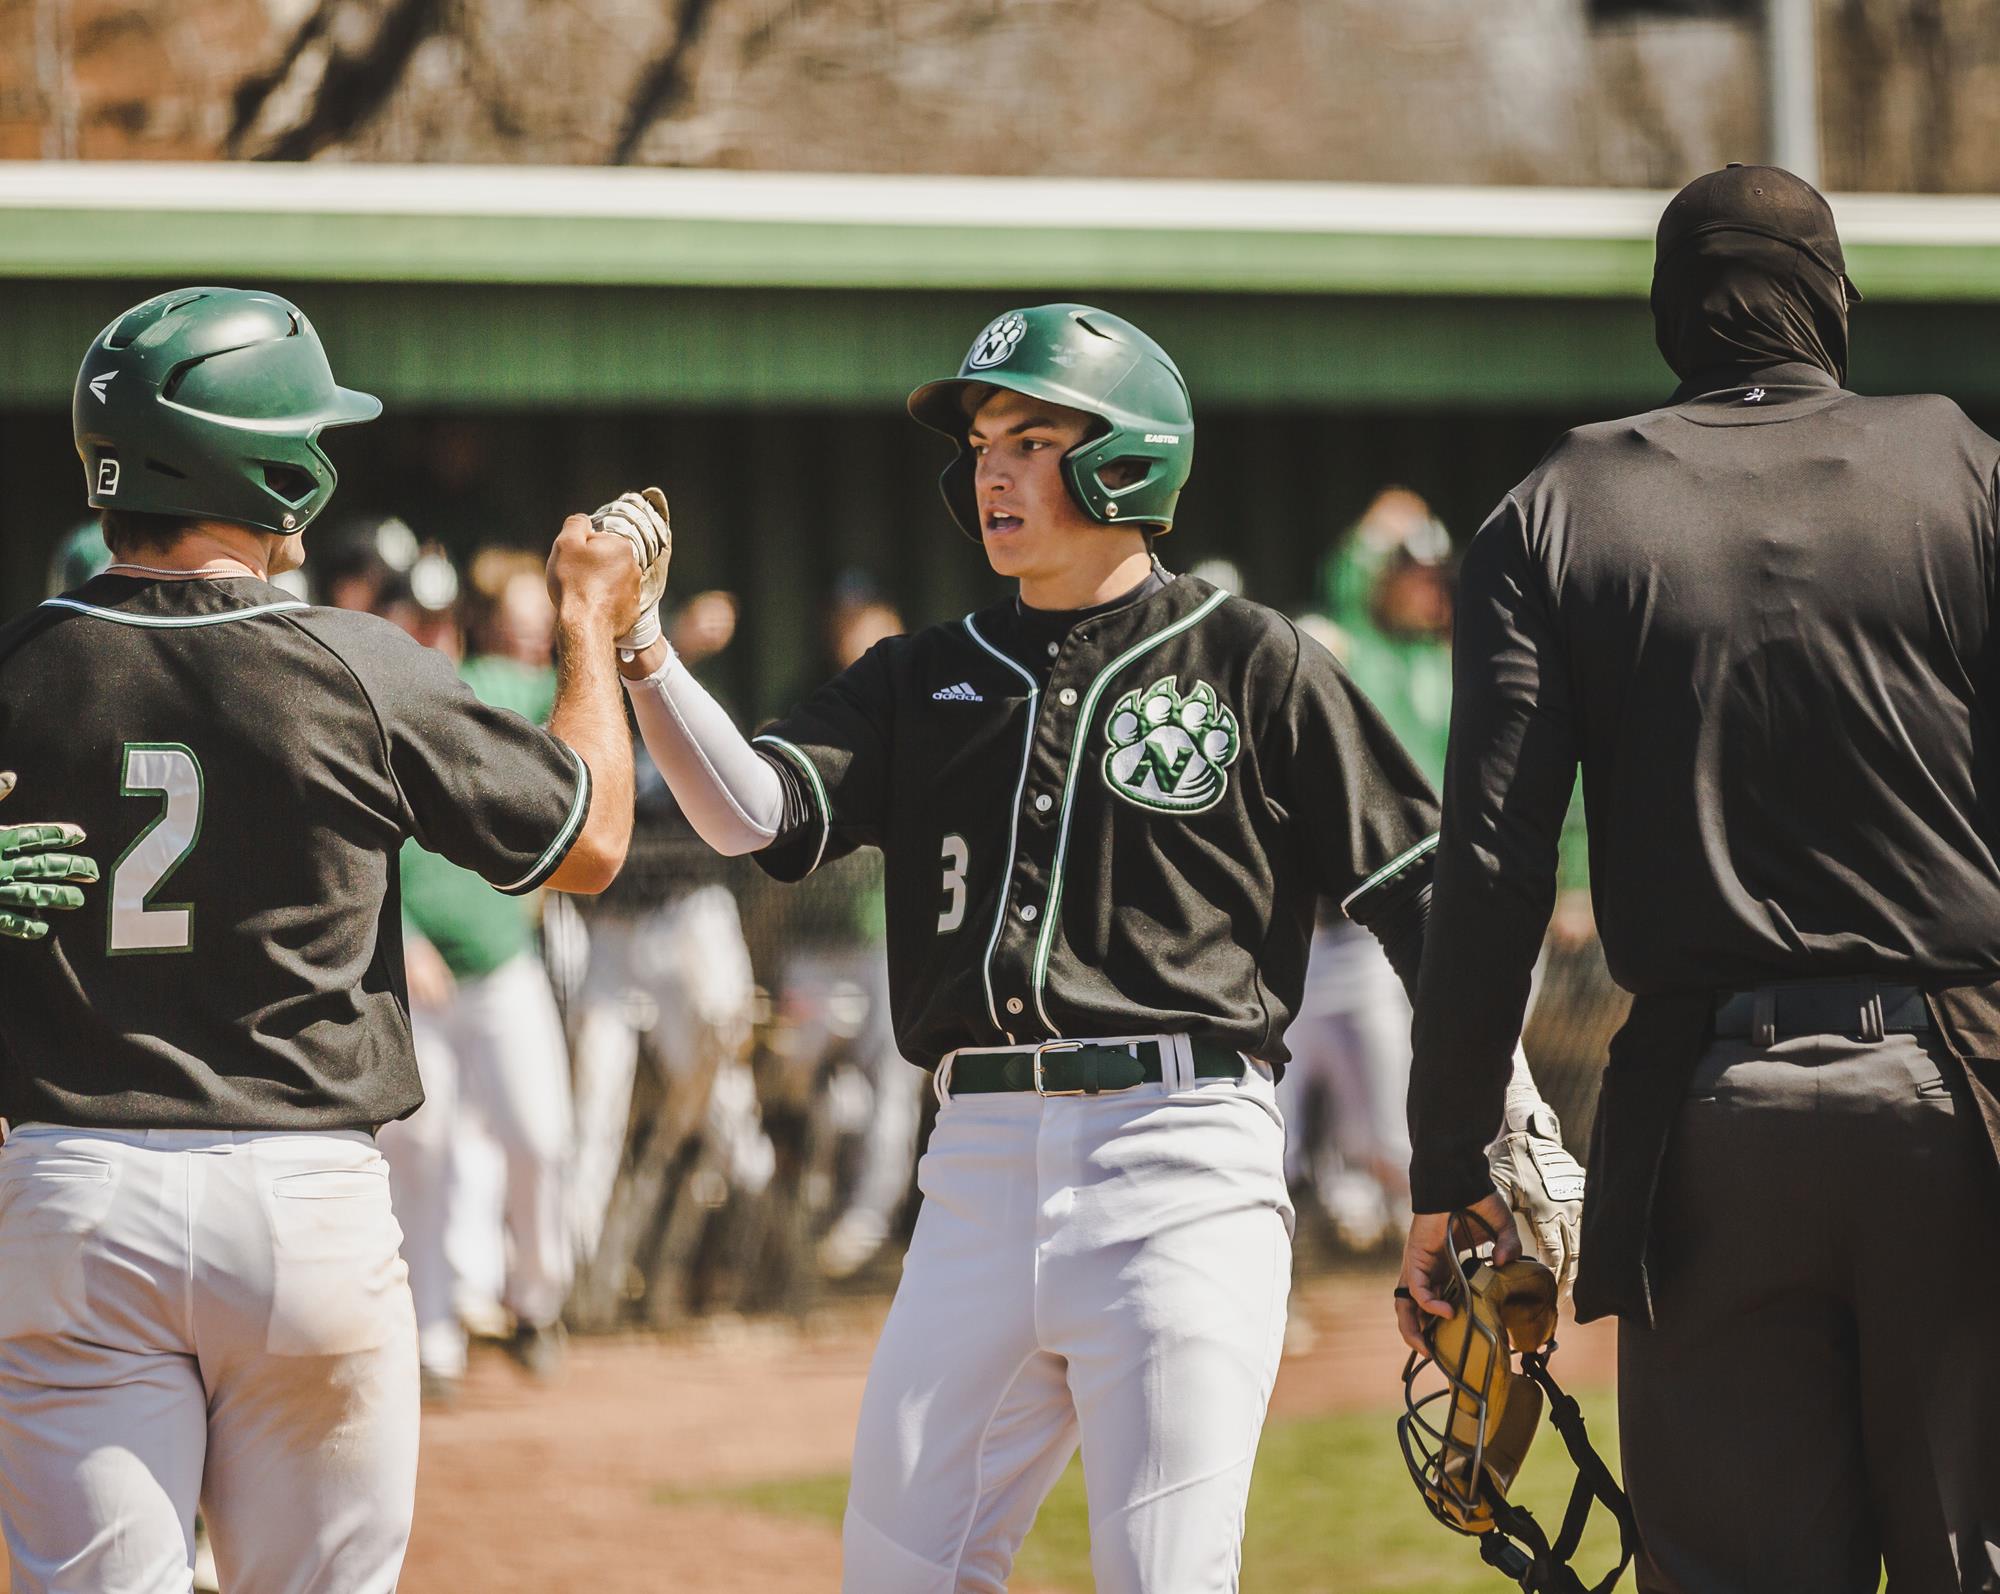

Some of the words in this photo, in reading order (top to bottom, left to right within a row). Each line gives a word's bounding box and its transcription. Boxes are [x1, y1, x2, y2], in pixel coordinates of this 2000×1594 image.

[976, 340, 1004, 361] N
[1144, 433, 1179, 444] EASTON
[97, 459, 120, 495] 2
[932, 691, 983, 701] adidas
[1123, 740, 1195, 795] N
[107, 742, 204, 956] 2
[937, 833, 970, 935] 3
